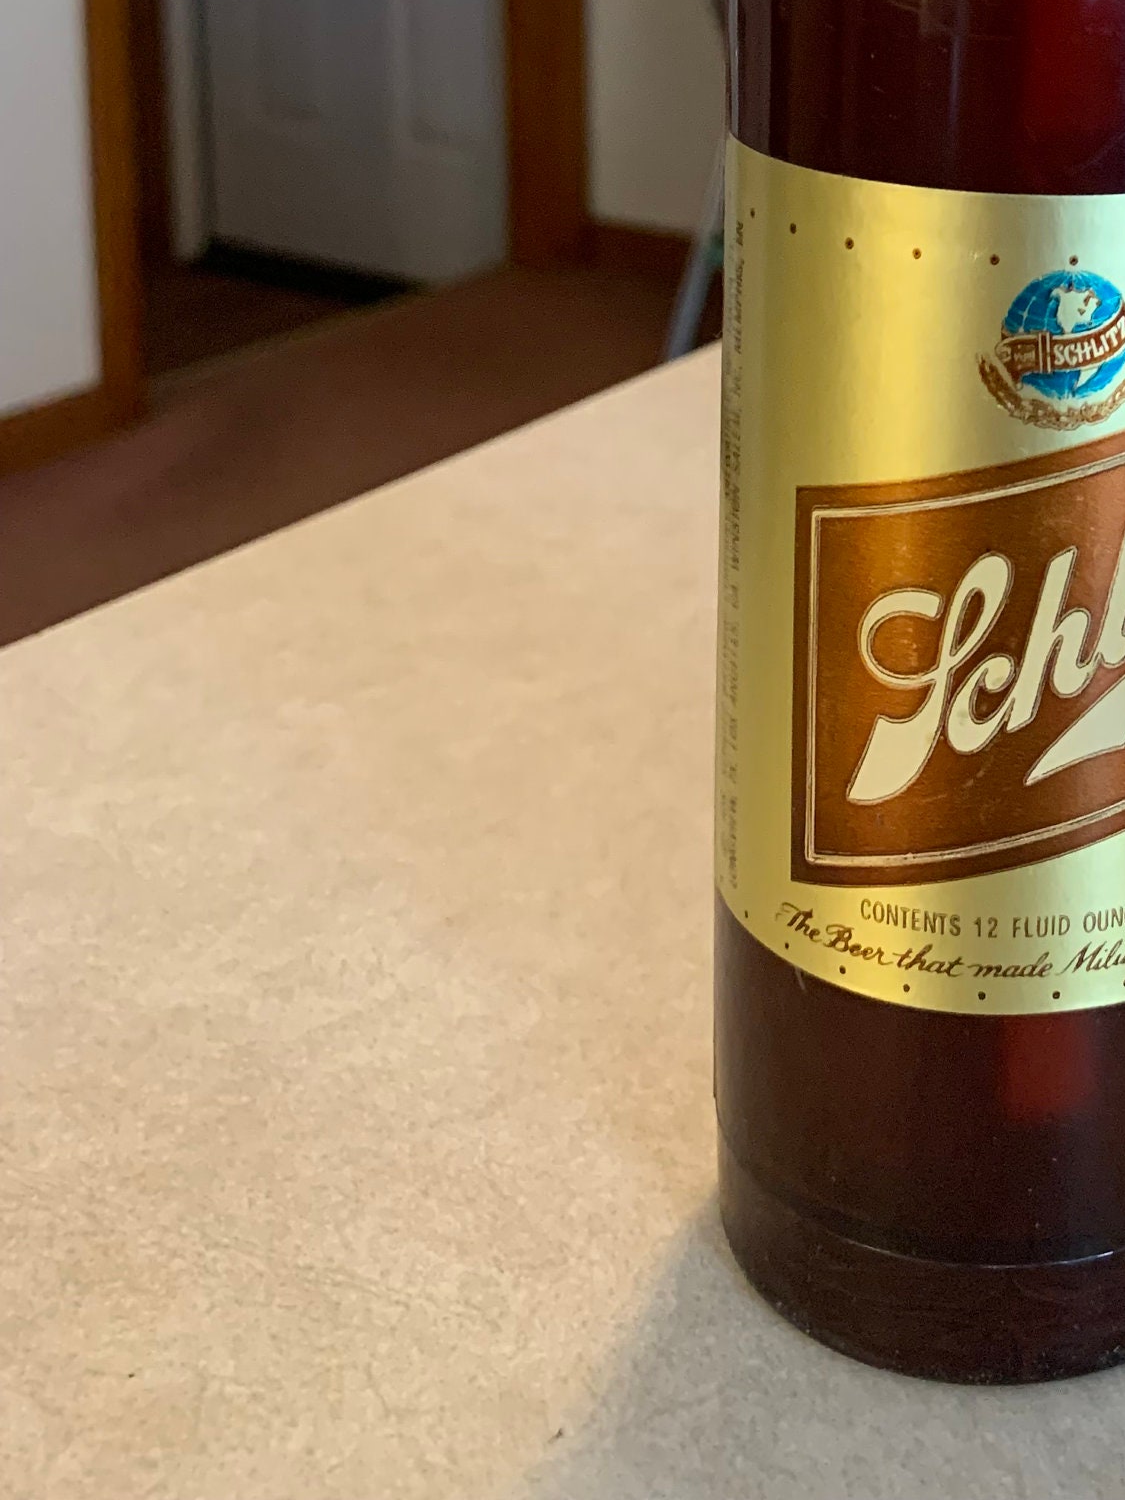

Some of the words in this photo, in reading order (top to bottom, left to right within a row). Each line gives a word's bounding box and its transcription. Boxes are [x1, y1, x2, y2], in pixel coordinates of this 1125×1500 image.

[775, 901, 822, 944] The
[822, 923, 894, 965] Beer
[892, 943, 966, 978] that
[967, 952, 1054, 978] made
[860, 898, 962, 937] CONTENTS
[974, 916, 998, 939] 12
[1012, 915, 1071, 938] FLUID
